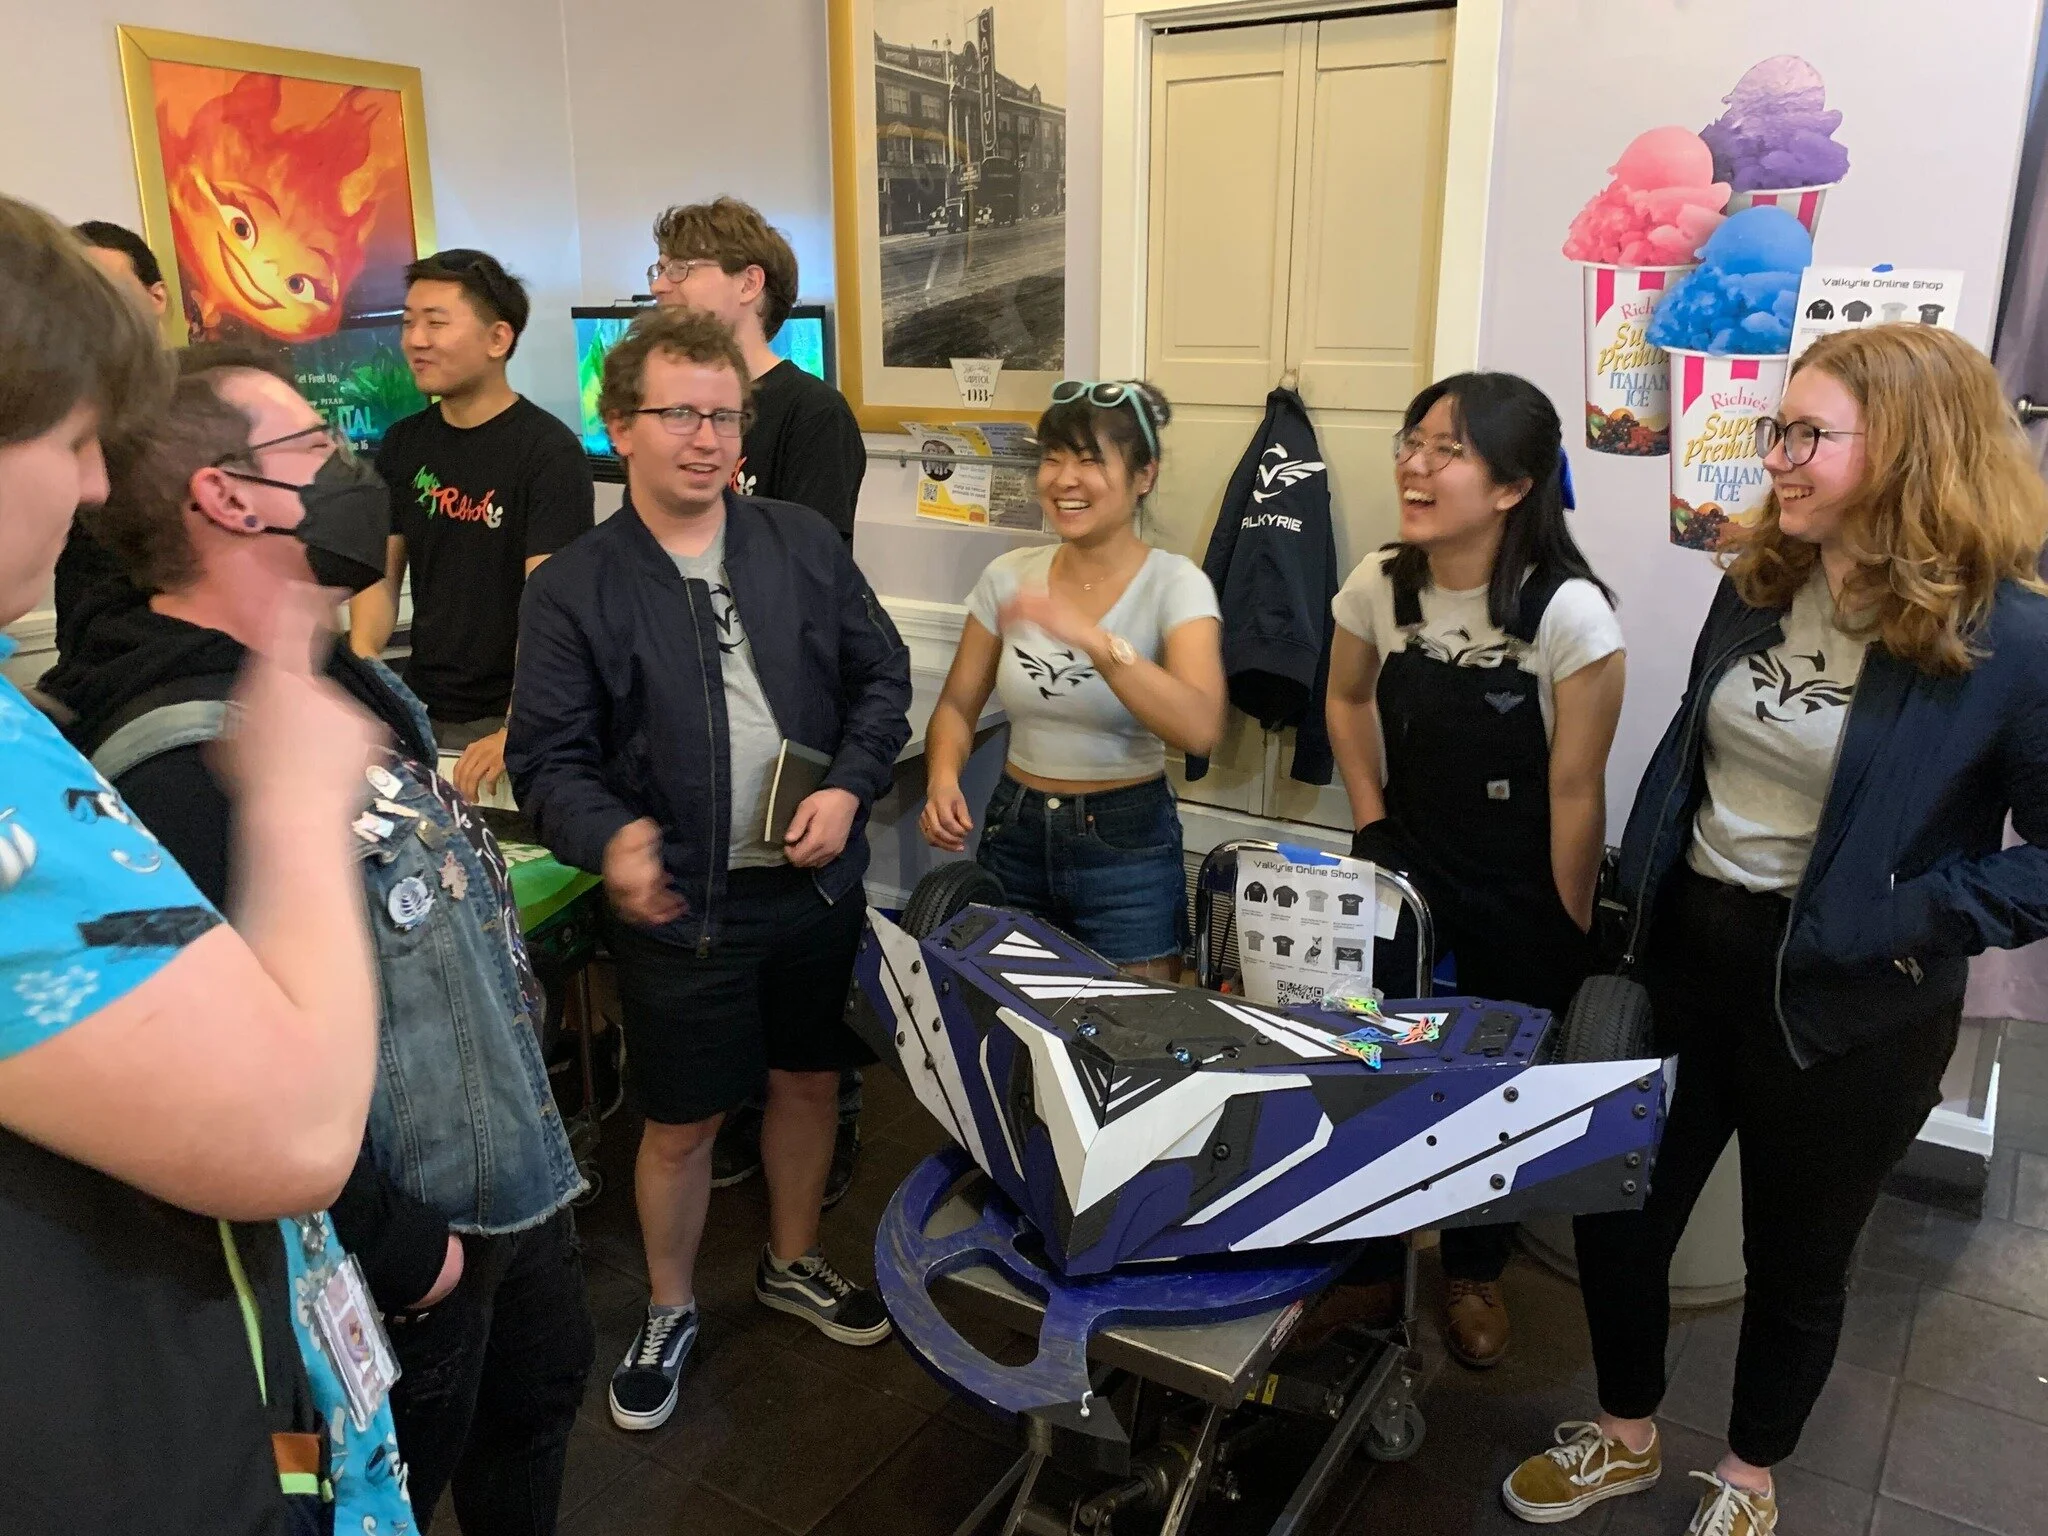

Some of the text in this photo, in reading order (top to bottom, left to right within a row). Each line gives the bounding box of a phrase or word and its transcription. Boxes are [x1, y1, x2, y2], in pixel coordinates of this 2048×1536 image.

[980, 17, 993, 145] CAPITOL
[1822, 278, 1944, 291] Valkyrie Online Shop
[1620, 296, 1656, 319] Rich
[1625, 389, 1650, 407] ICE
[1711, 386, 1768, 411] Richie's
[1703, 412, 1758, 442] Supe
[1697, 464, 1765, 485] ITALIAN
[1714, 483, 1741, 502] ICE
[1241, 513, 1303, 533] ALKYRIE
[1254, 860, 1359, 881] Valkyrie Online Shop
